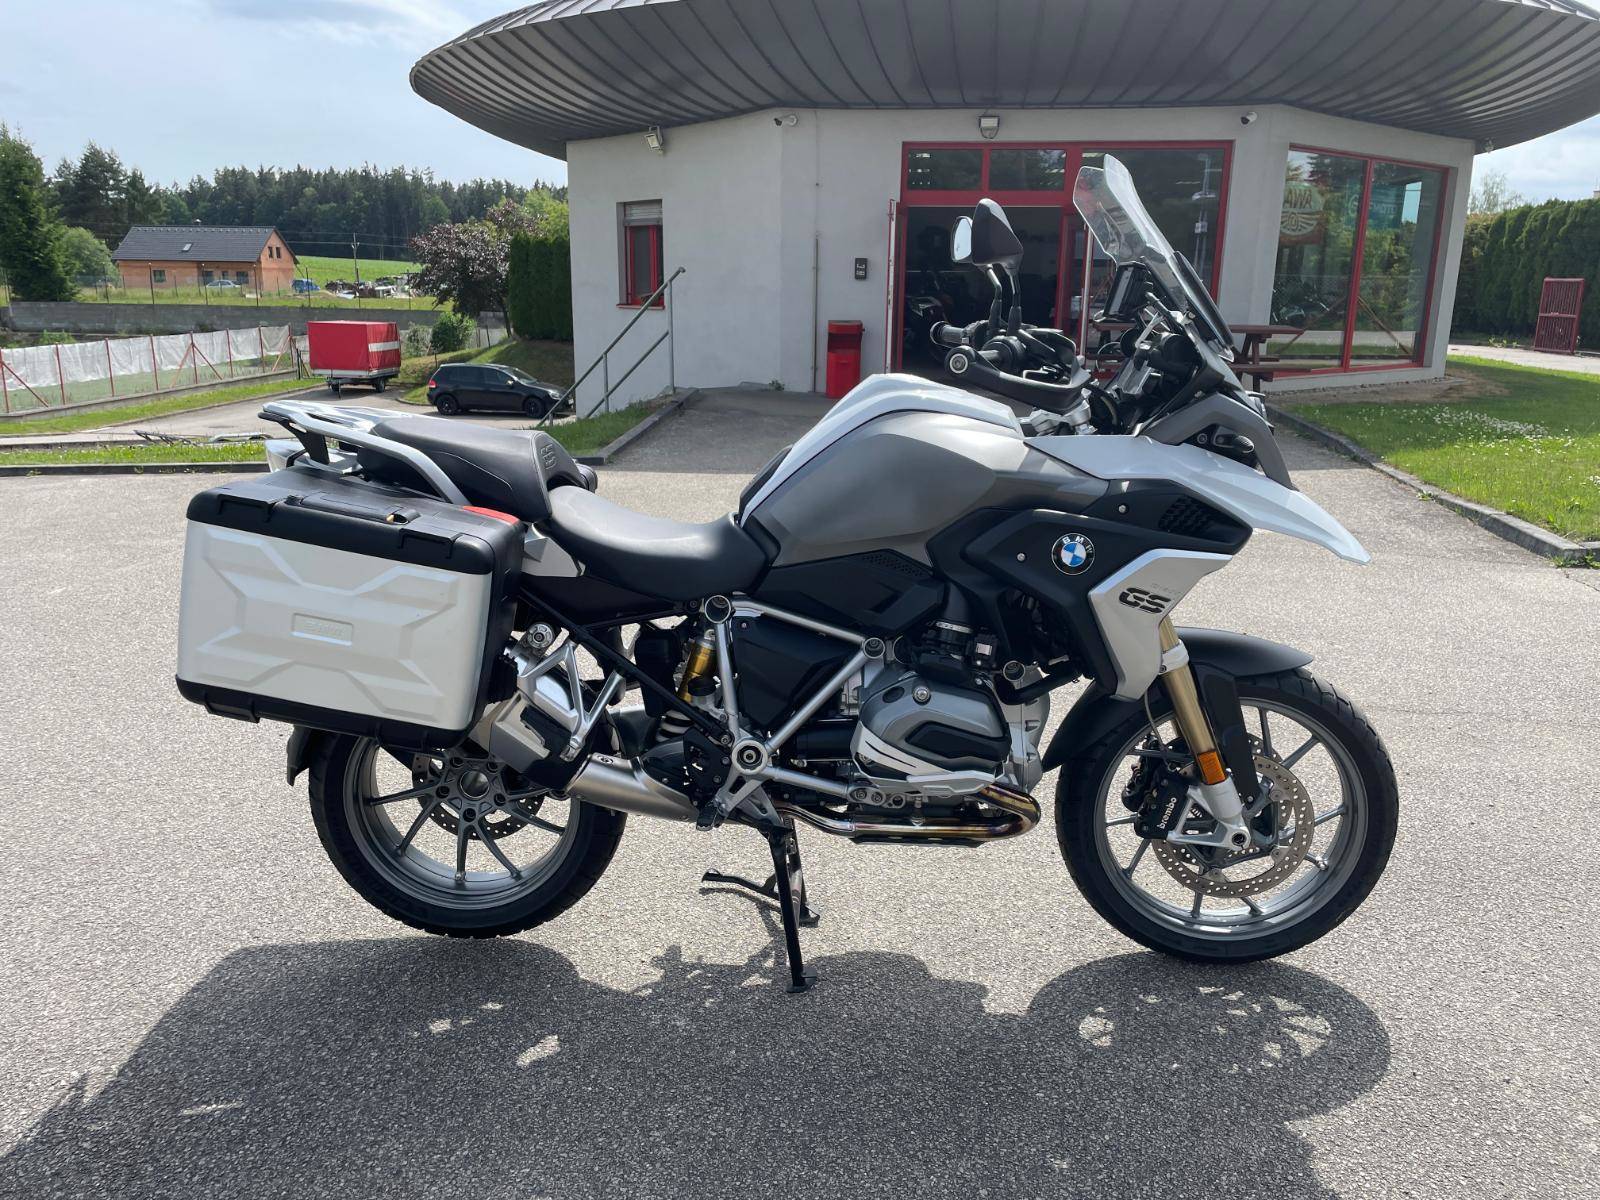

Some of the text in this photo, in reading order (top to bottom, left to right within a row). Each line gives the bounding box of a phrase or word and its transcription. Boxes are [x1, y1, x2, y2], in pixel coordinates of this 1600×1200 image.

[1282, 187, 1312, 209] AWA
[1062, 536, 1092, 553] BMW
[1119, 587, 1172, 614] GS
[1156, 797, 1177, 830] brembo
